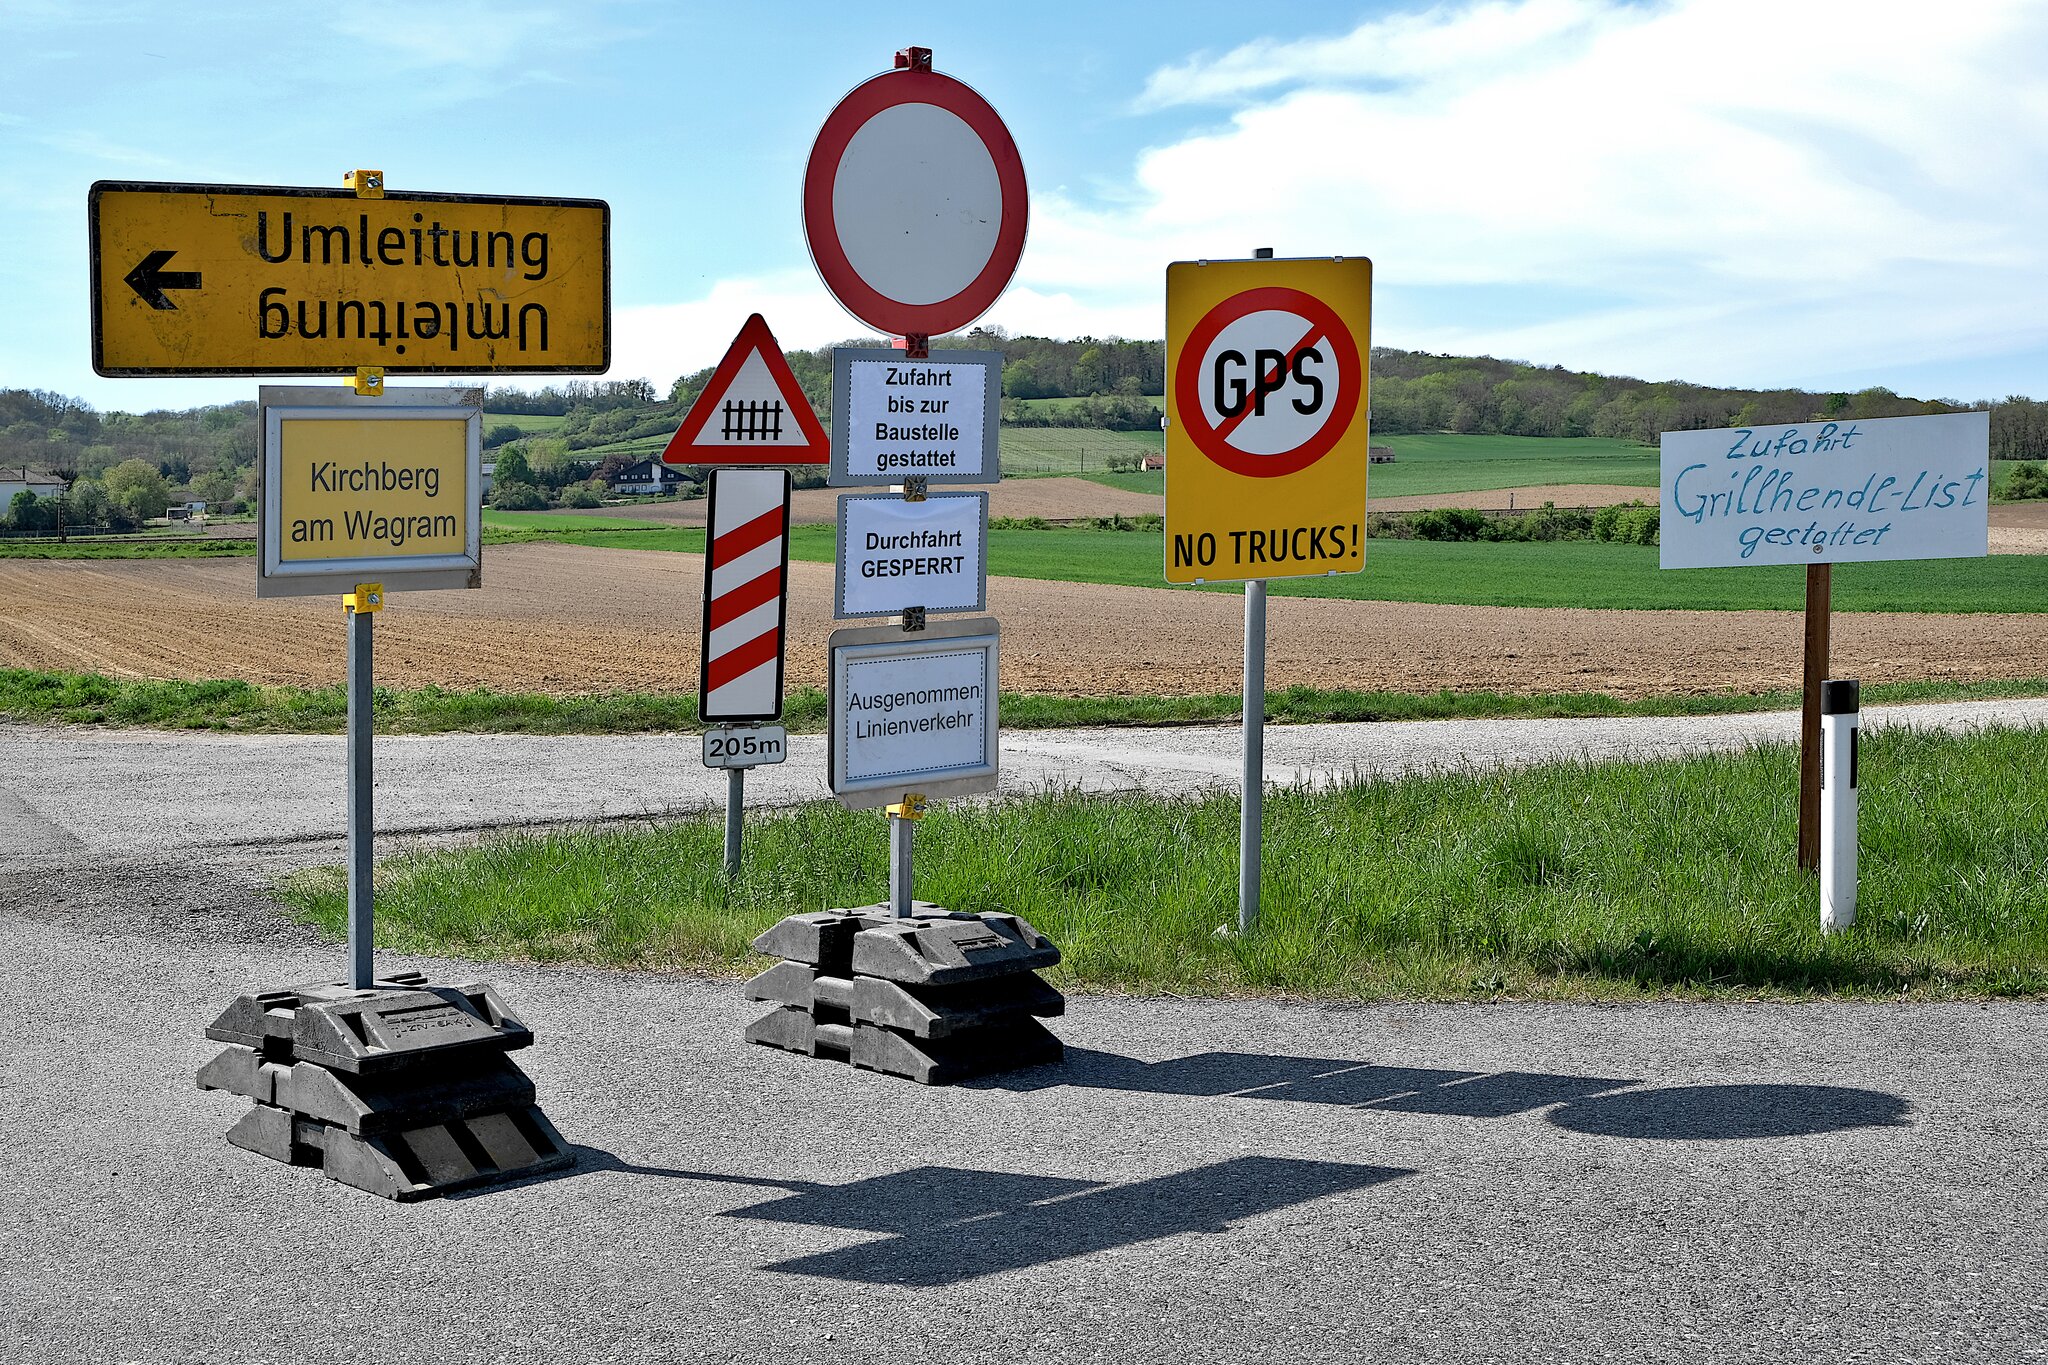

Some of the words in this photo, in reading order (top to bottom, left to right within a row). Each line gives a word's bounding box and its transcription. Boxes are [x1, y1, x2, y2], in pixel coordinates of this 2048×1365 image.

[257, 211, 548, 281] Umleitung
[257, 287, 549, 355] Umleitung
[885, 367, 953, 388] Zufahrt
[1213, 346, 1325, 419] GPS
[887, 396, 915, 414] bis
[919, 399, 950, 415] zur
[875, 423, 960, 443] Baustelle
[1726, 422, 1864, 460] Zufahrt
[876, 449, 957, 473] gestattet
[310, 461, 440, 497] Kirchberg
[291, 516, 334, 543] am
[343, 509, 457, 547] Wagram
[865, 529, 963, 551] Durchfahrt
[1739, 521, 1892, 559] gestattet
[1173, 532, 1217, 568] NO
[1228, 523, 1359, 565] TRUCKS!
[861, 556, 965, 579] GESPERRT
[848, 682, 981, 714] Ausgenommen
[855, 710, 974, 740] Linienverkehr
[709, 740, 781, 759] 205m
